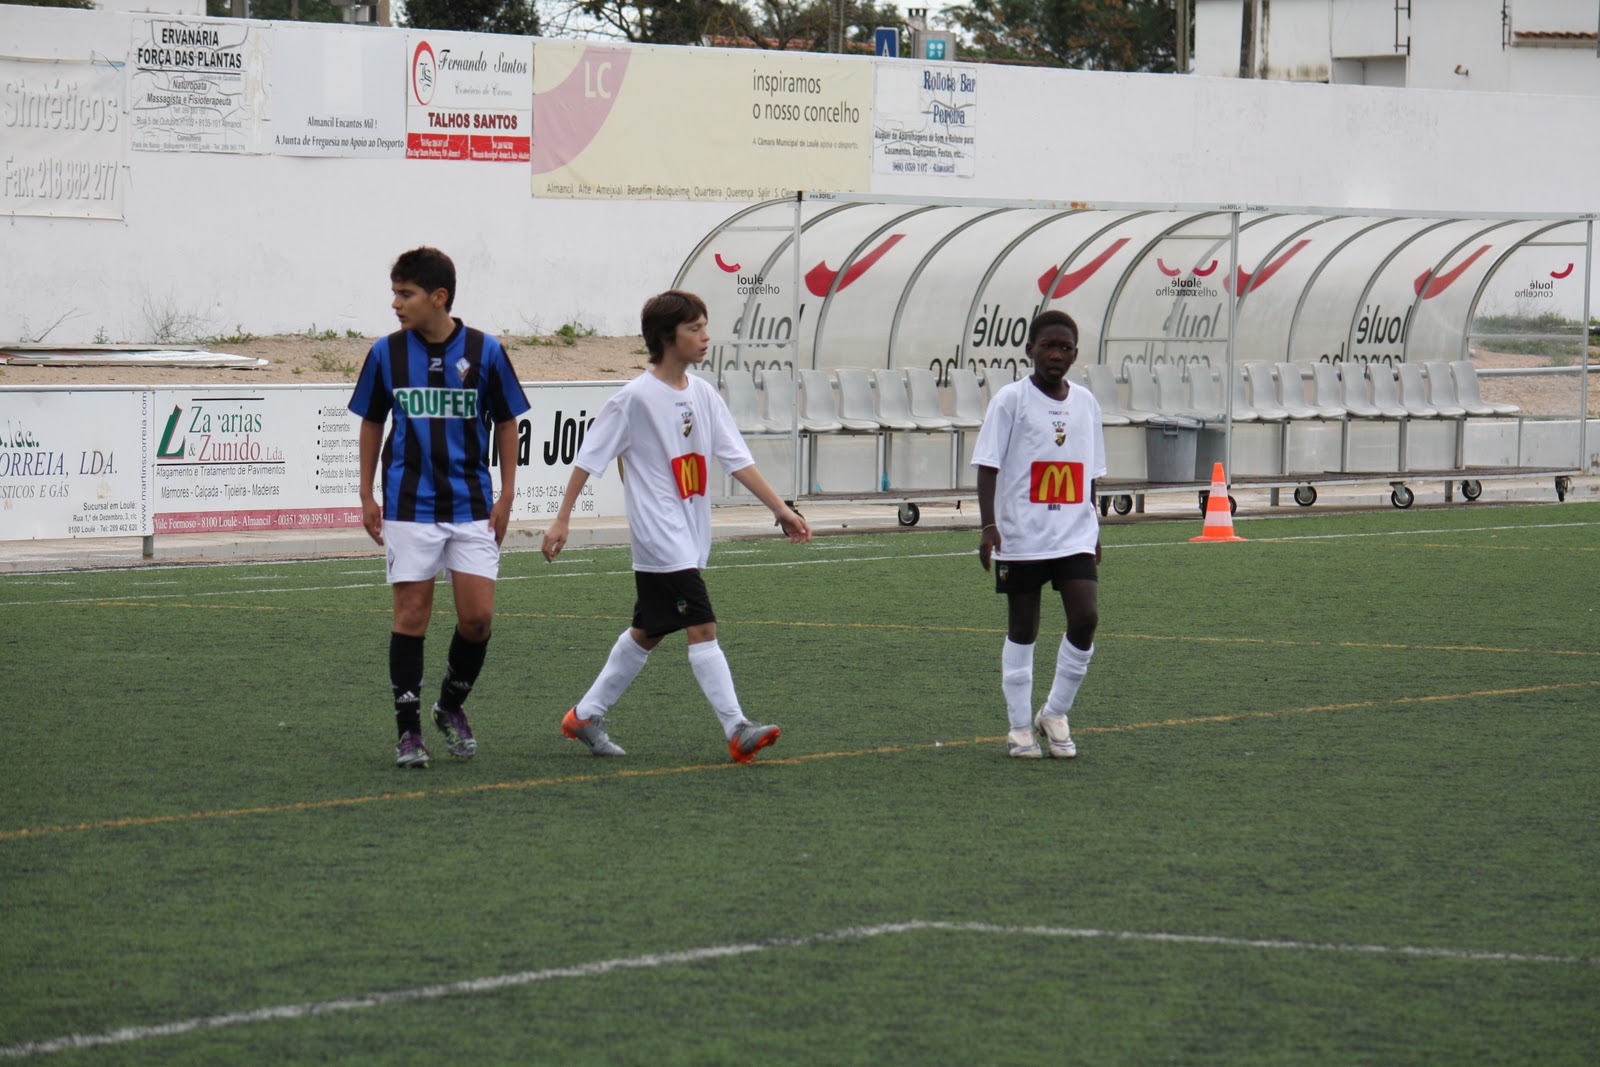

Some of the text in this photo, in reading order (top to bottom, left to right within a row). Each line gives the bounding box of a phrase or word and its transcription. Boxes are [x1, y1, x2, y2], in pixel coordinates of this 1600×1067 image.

[162, 26, 219, 46] ERVANÁRIA
[138, 48, 242, 68] FORÇA DAS PLANTAS
[438, 49, 527, 74] Fernando Santos
[173, 80, 207, 92] Naturopata
[585, 60, 611, 98] LC
[753, 69, 821, 97] inspiramos
[924, 70, 976, 92] Rollote Bar
[147, 93, 182, 106] Massagista
[188, 95, 232, 107] Fisioterapeuta
[752, 101, 860, 123] o nosso concelho
[933, 103, 965, 124] Pereira
[307, 116, 335, 127] Almancil
[335, 117, 363, 129] Encantos
[364, 118, 374, 129] Mil
[428, 112, 518, 130] TALHOS SANTOS
[275, 134, 405, 151] A Junta de Freguesia no Apoio ao Desporto
[757, 137, 775, 146] Câmara
[776, 138, 799, 148] Municipal
[799, 139, 806, 147] de
[806, 139, 819, 148] Loulé
[546, 183, 574, 194] Almancil
[579, 184, 592, 195] Alte
[596, 185, 623, 196] Ameixial
[627, 185, 653, 196] Benafim
[656, 185, 690, 198] Boliqueime
[694, 186, 723, 198] Quarteira
[726, 187, 754, 199] Querença
[737, 273, 764, 285] loulé
[737, 284, 780, 295] concelho
[189, 405, 262, 433] Zaarias
[543, 410, 597, 466] Joi
[188, 442, 196, 456] &
[266, 446, 285, 460] Lda.
[79, 450, 118, 475] LDA.
[156, 464, 286, 480] Afagamento e Tratamento de Pavimentos
[39, 480, 70, 498] E GÁS
[161, 485, 190, 499] Mármores
[194, 485, 219, 500] Calçada
[252, 483, 280, 496] Madeiras
[527, 486, 558, 498] 8135-125
[83, 502, 109, 511] Sucursal
[528, 502, 541, 513] Fax:
[546, 501, 559, 513] 289
[581, 500, 594, 512] 066
[73, 514, 84, 522] Rua
[155, 519, 167, 529] Vale
[169, 518, 197, 529] Formoso
[201, 517, 218, 528] 8100
[219, 516, 237, 527] Loulé
[242, 515, 271, 526] Almancil
[278, 514, 297, 526] 00351
[298, 514, 310, 525] 289
[323, 513, 334, 524] 911
[68, 525, 80, 534] 8100
[110, 524, 118, 532] 289
